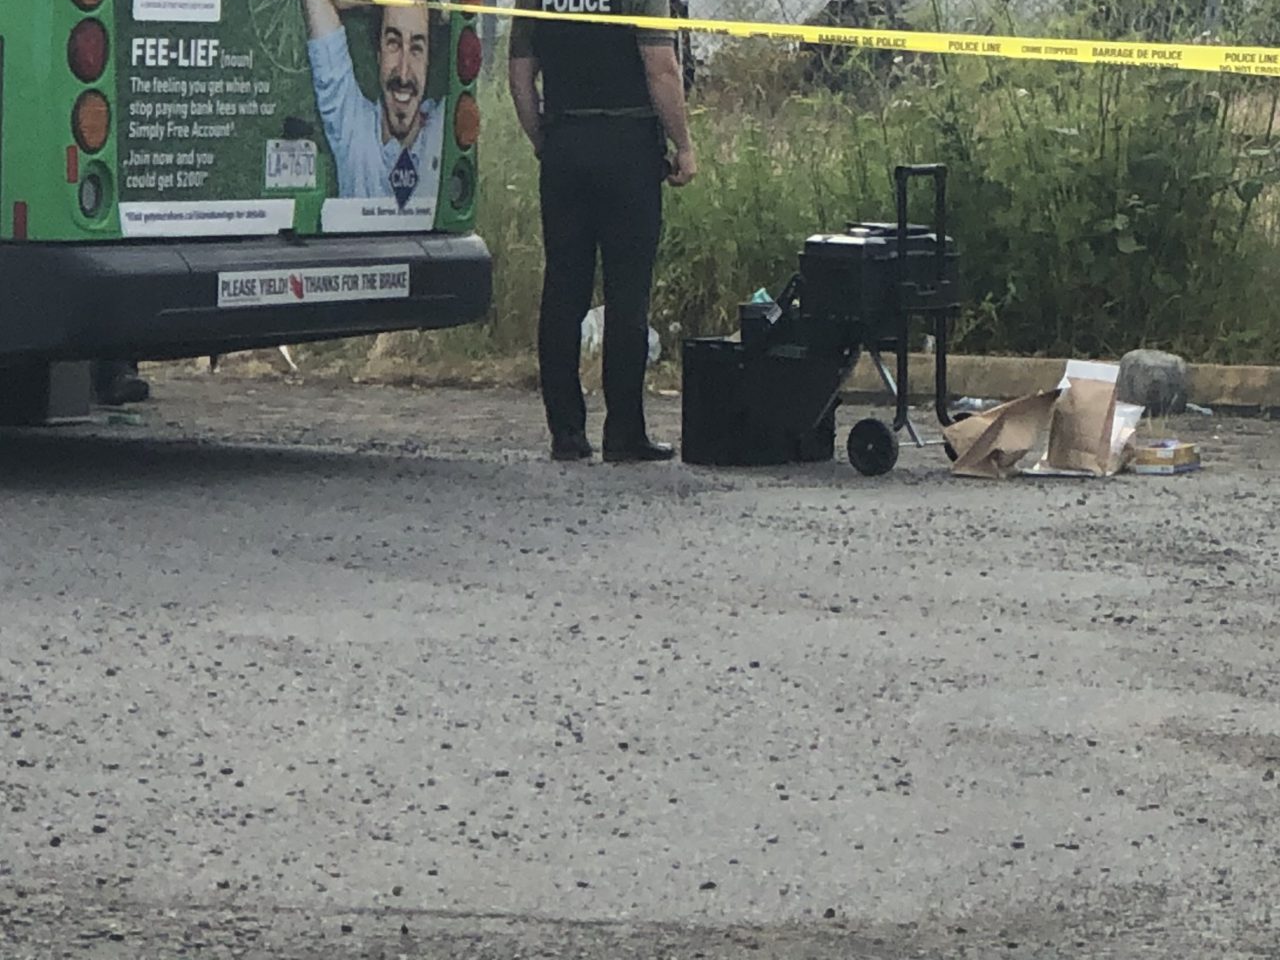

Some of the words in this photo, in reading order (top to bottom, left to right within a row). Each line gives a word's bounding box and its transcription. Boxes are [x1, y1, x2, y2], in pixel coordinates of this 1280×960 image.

[818, 34, 859, 45] BARRAGE
[862, 36, 874, 47] DE
[876, 37, 907, 48] POLICE
[948, 40, 979, 51] POLICE
[981, 42, 1002, 53] LINE
[132, 37, 219, 67] FEE-LIEF
[1044, 46, 1078, 56] STOPPERS
[1092, 47, 1133, 58] BARRAGE
[1137, 49, 1149, 59] DE
[1151, 49, 1183, 60] POLICE
[1224, 52, 1256, 63] POLICE
[1258, 54, 1279, 64] LINE
[130, 76, 150, 93] The
[153, 77, 187, 96] feeling
[189, 81, 206, 96] you
[208, 79, 224, 96] get
[226, 77, 251, 93] when
[254, 81, 270, 96] you
[129, 101, 153, 119] stop
[155, 101, 188, 119] paying
[190, 99, 213, 115] bank
[216, 99, 236, 115] fees
[238, 100, 258, 115] with
[260, 103, 277, 115] our
[128, 121, 165, 140] Simply
[167, 121, 190, 137] Free
[128, 149, 150, 165] Join
[152, 152, 174, 165] now
[176, 149, 194, 165] and
[196, 152, 214, 168] you
[126, 171, 156, 188] could
[158, 173, 174, 191] get
[391, 169, 416, 188] CNG
[221, 278, 256, 297] PLEASE
[259, 277, 289, 295] YIELD!
[304, 274, 340, 293] THANKS
[341, 274, 359, 291] FOR
[361, 273, 377, 290] THE
[379, 271, 407, 289] BRAKE
